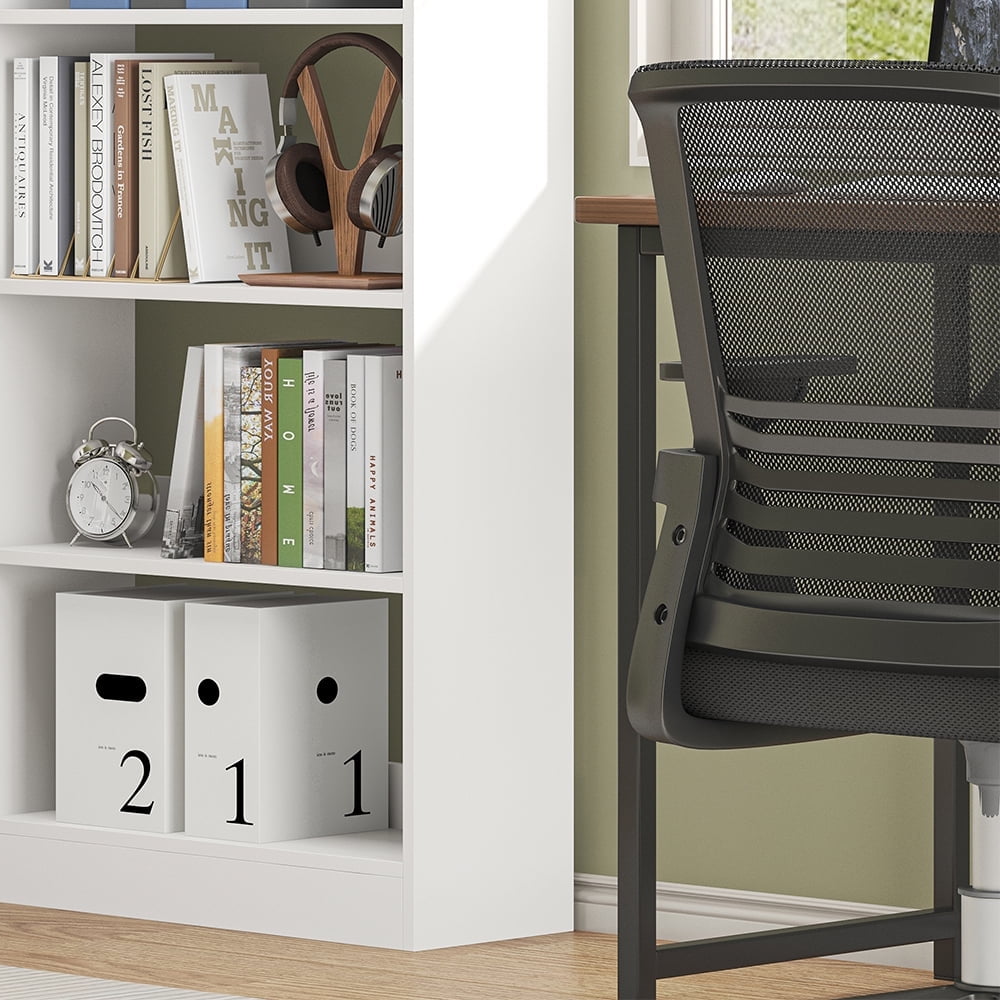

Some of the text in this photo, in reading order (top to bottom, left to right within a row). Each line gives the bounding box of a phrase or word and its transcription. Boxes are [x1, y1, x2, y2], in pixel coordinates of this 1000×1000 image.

[117, 125, 125, 168] Gardens
[142, 68, 152, 160] LOST FISH
[167, 86, 182, 152] MAKING IT
[18, 112, 26, 218] ANTIQUAIRES
[92, 59, 104, 262] ALEXEY BRODOVITCH
[117, 170, 124, 180] in
[228, 199, 268, 228] NG
[244, 242, 272, 270] IT
[350, 412, 357, 423] OF
[120, 750, 154, 815] 2
[224, 758, 254, 826] 1
[343, 749, 371, 818] 1
